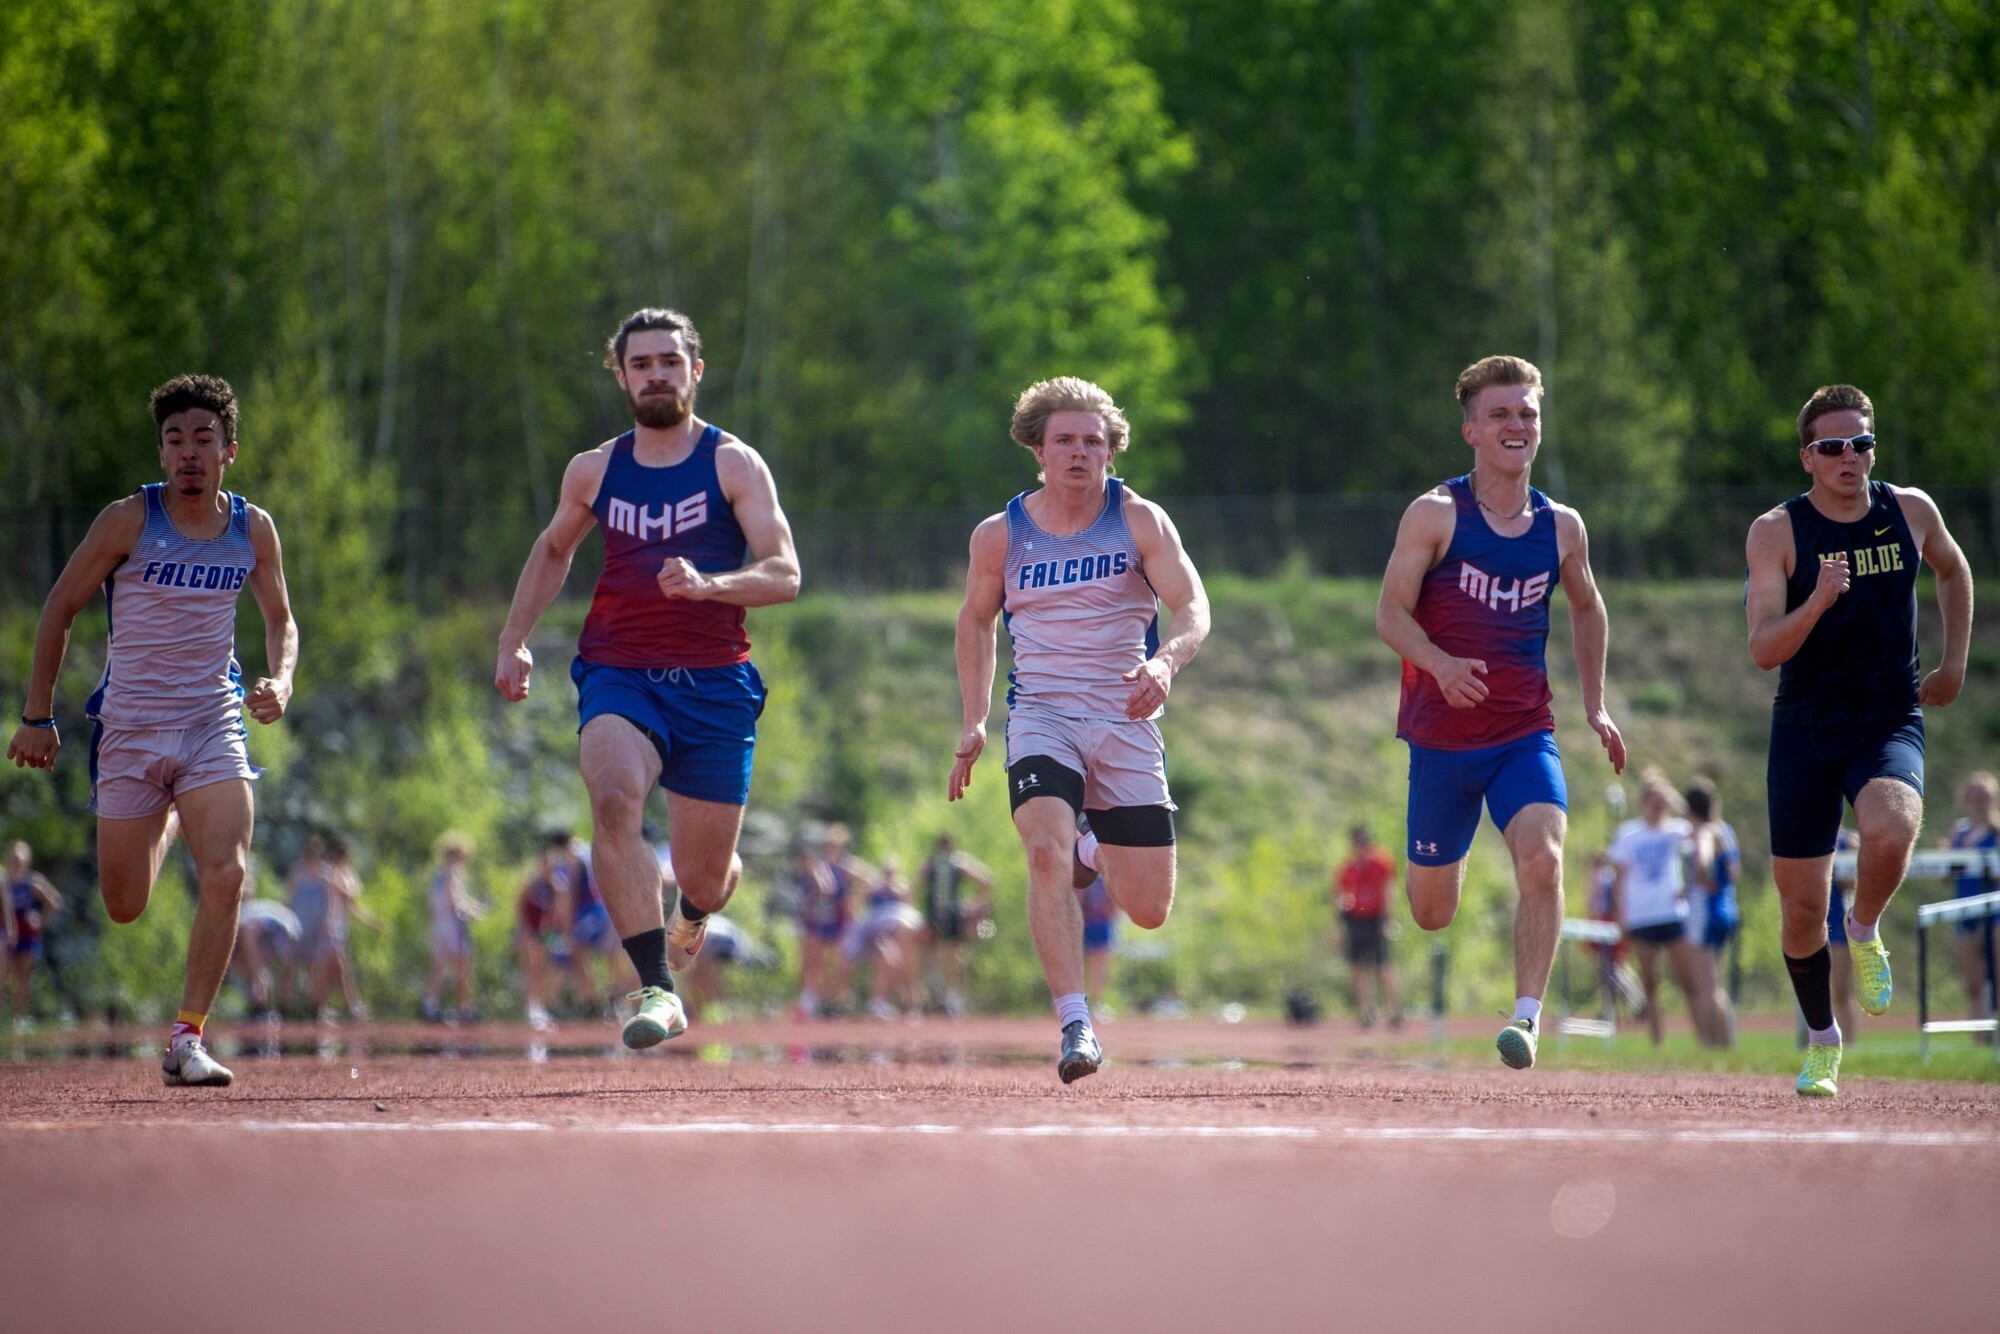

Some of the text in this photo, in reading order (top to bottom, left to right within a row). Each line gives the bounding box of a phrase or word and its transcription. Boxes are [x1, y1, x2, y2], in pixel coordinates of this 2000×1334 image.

[608, 490, 707, 541] MHS
[142, 560, 248, 591] FALCONS
[1018, 551, 1128, 591] FALCONS
[1854, 543, 1904, 576] BLUE
[1459, 561, 1550, 613] MHS
